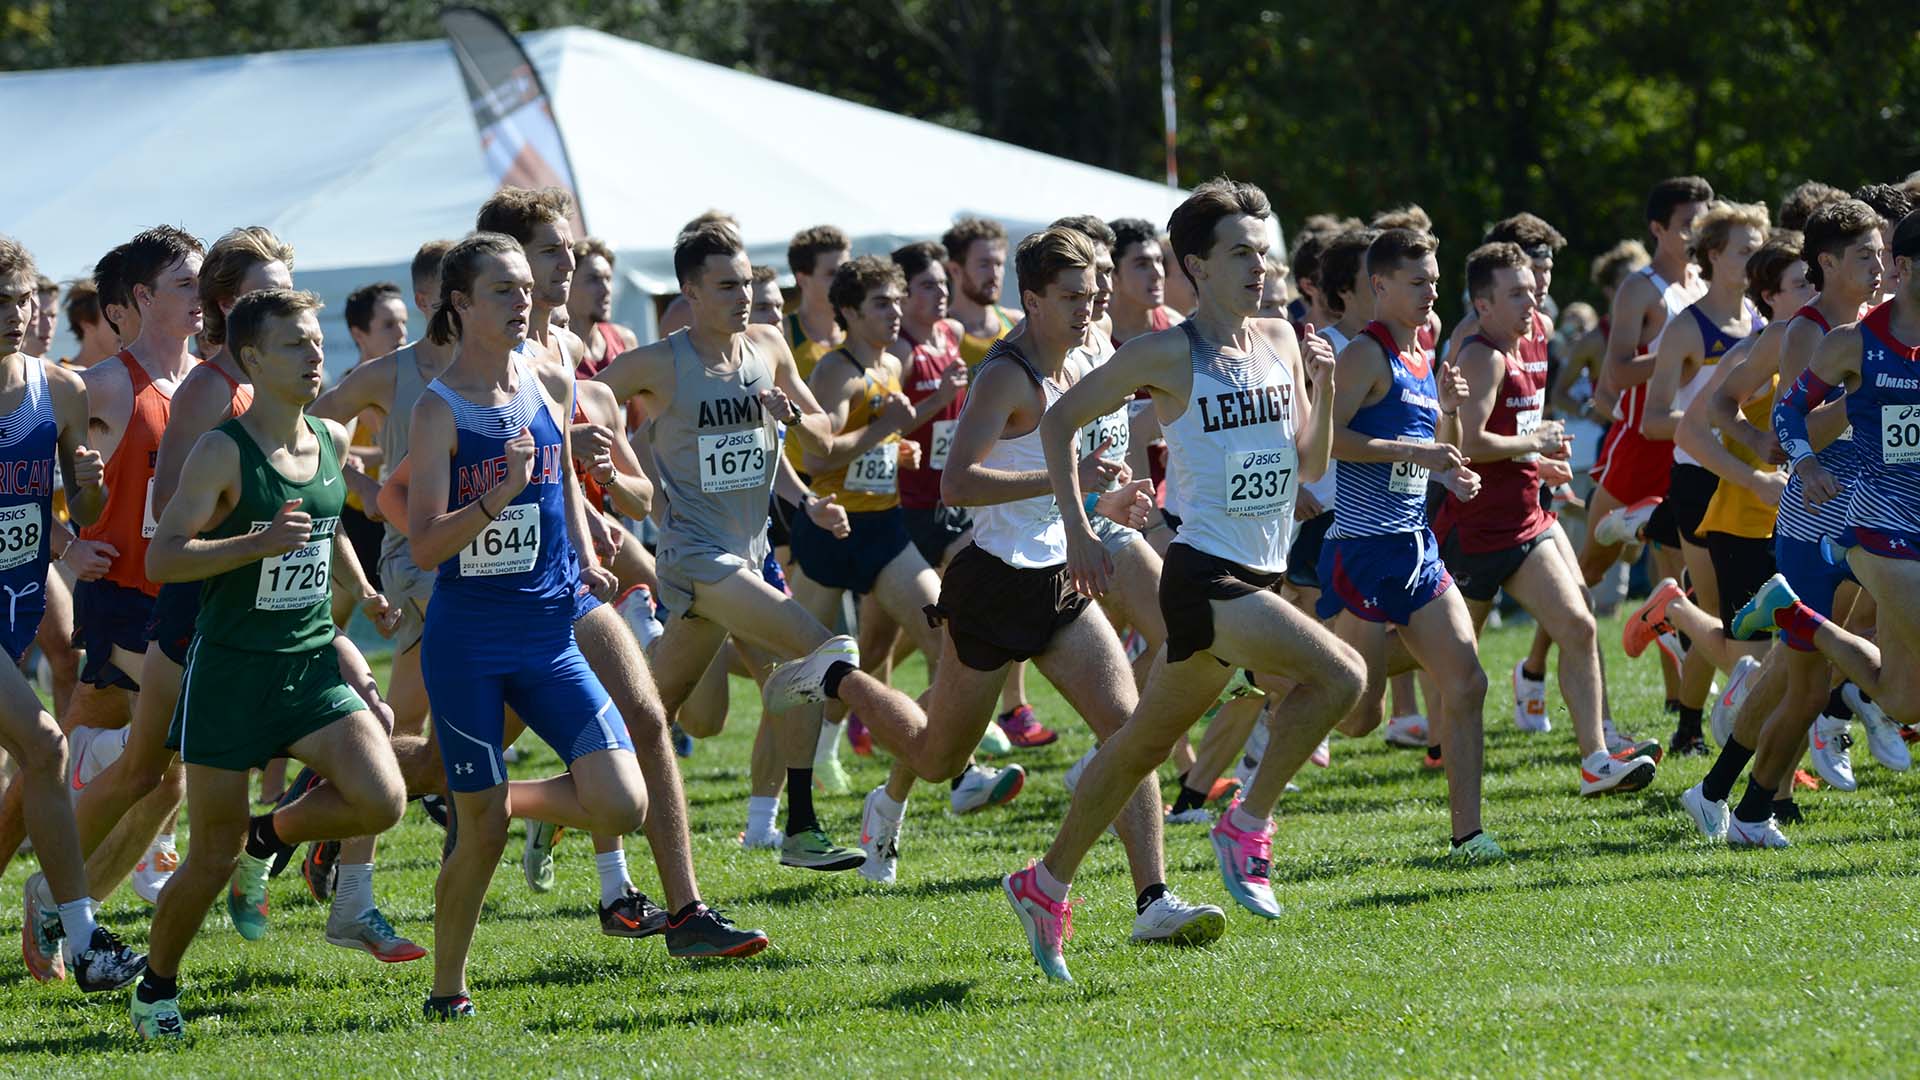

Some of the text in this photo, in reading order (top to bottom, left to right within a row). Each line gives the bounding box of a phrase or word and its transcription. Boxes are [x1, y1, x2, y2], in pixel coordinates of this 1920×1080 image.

[698, 394, 764, 428] ARMY
[1197, 384, 1291, 433] LEHIGH
[729, 434, 753, 446] asics
[1087, 424, 1127, 451] 1669
[458, 443, 562, 505] AMECAN
[705, 447, 764, 476] 1673
[1256, 452, 1281, 465] asics
[1231, 468, 1291, 501] 2337
[472, 525, 538, 557] 1644
[268, 561, 326, 592] 1726
